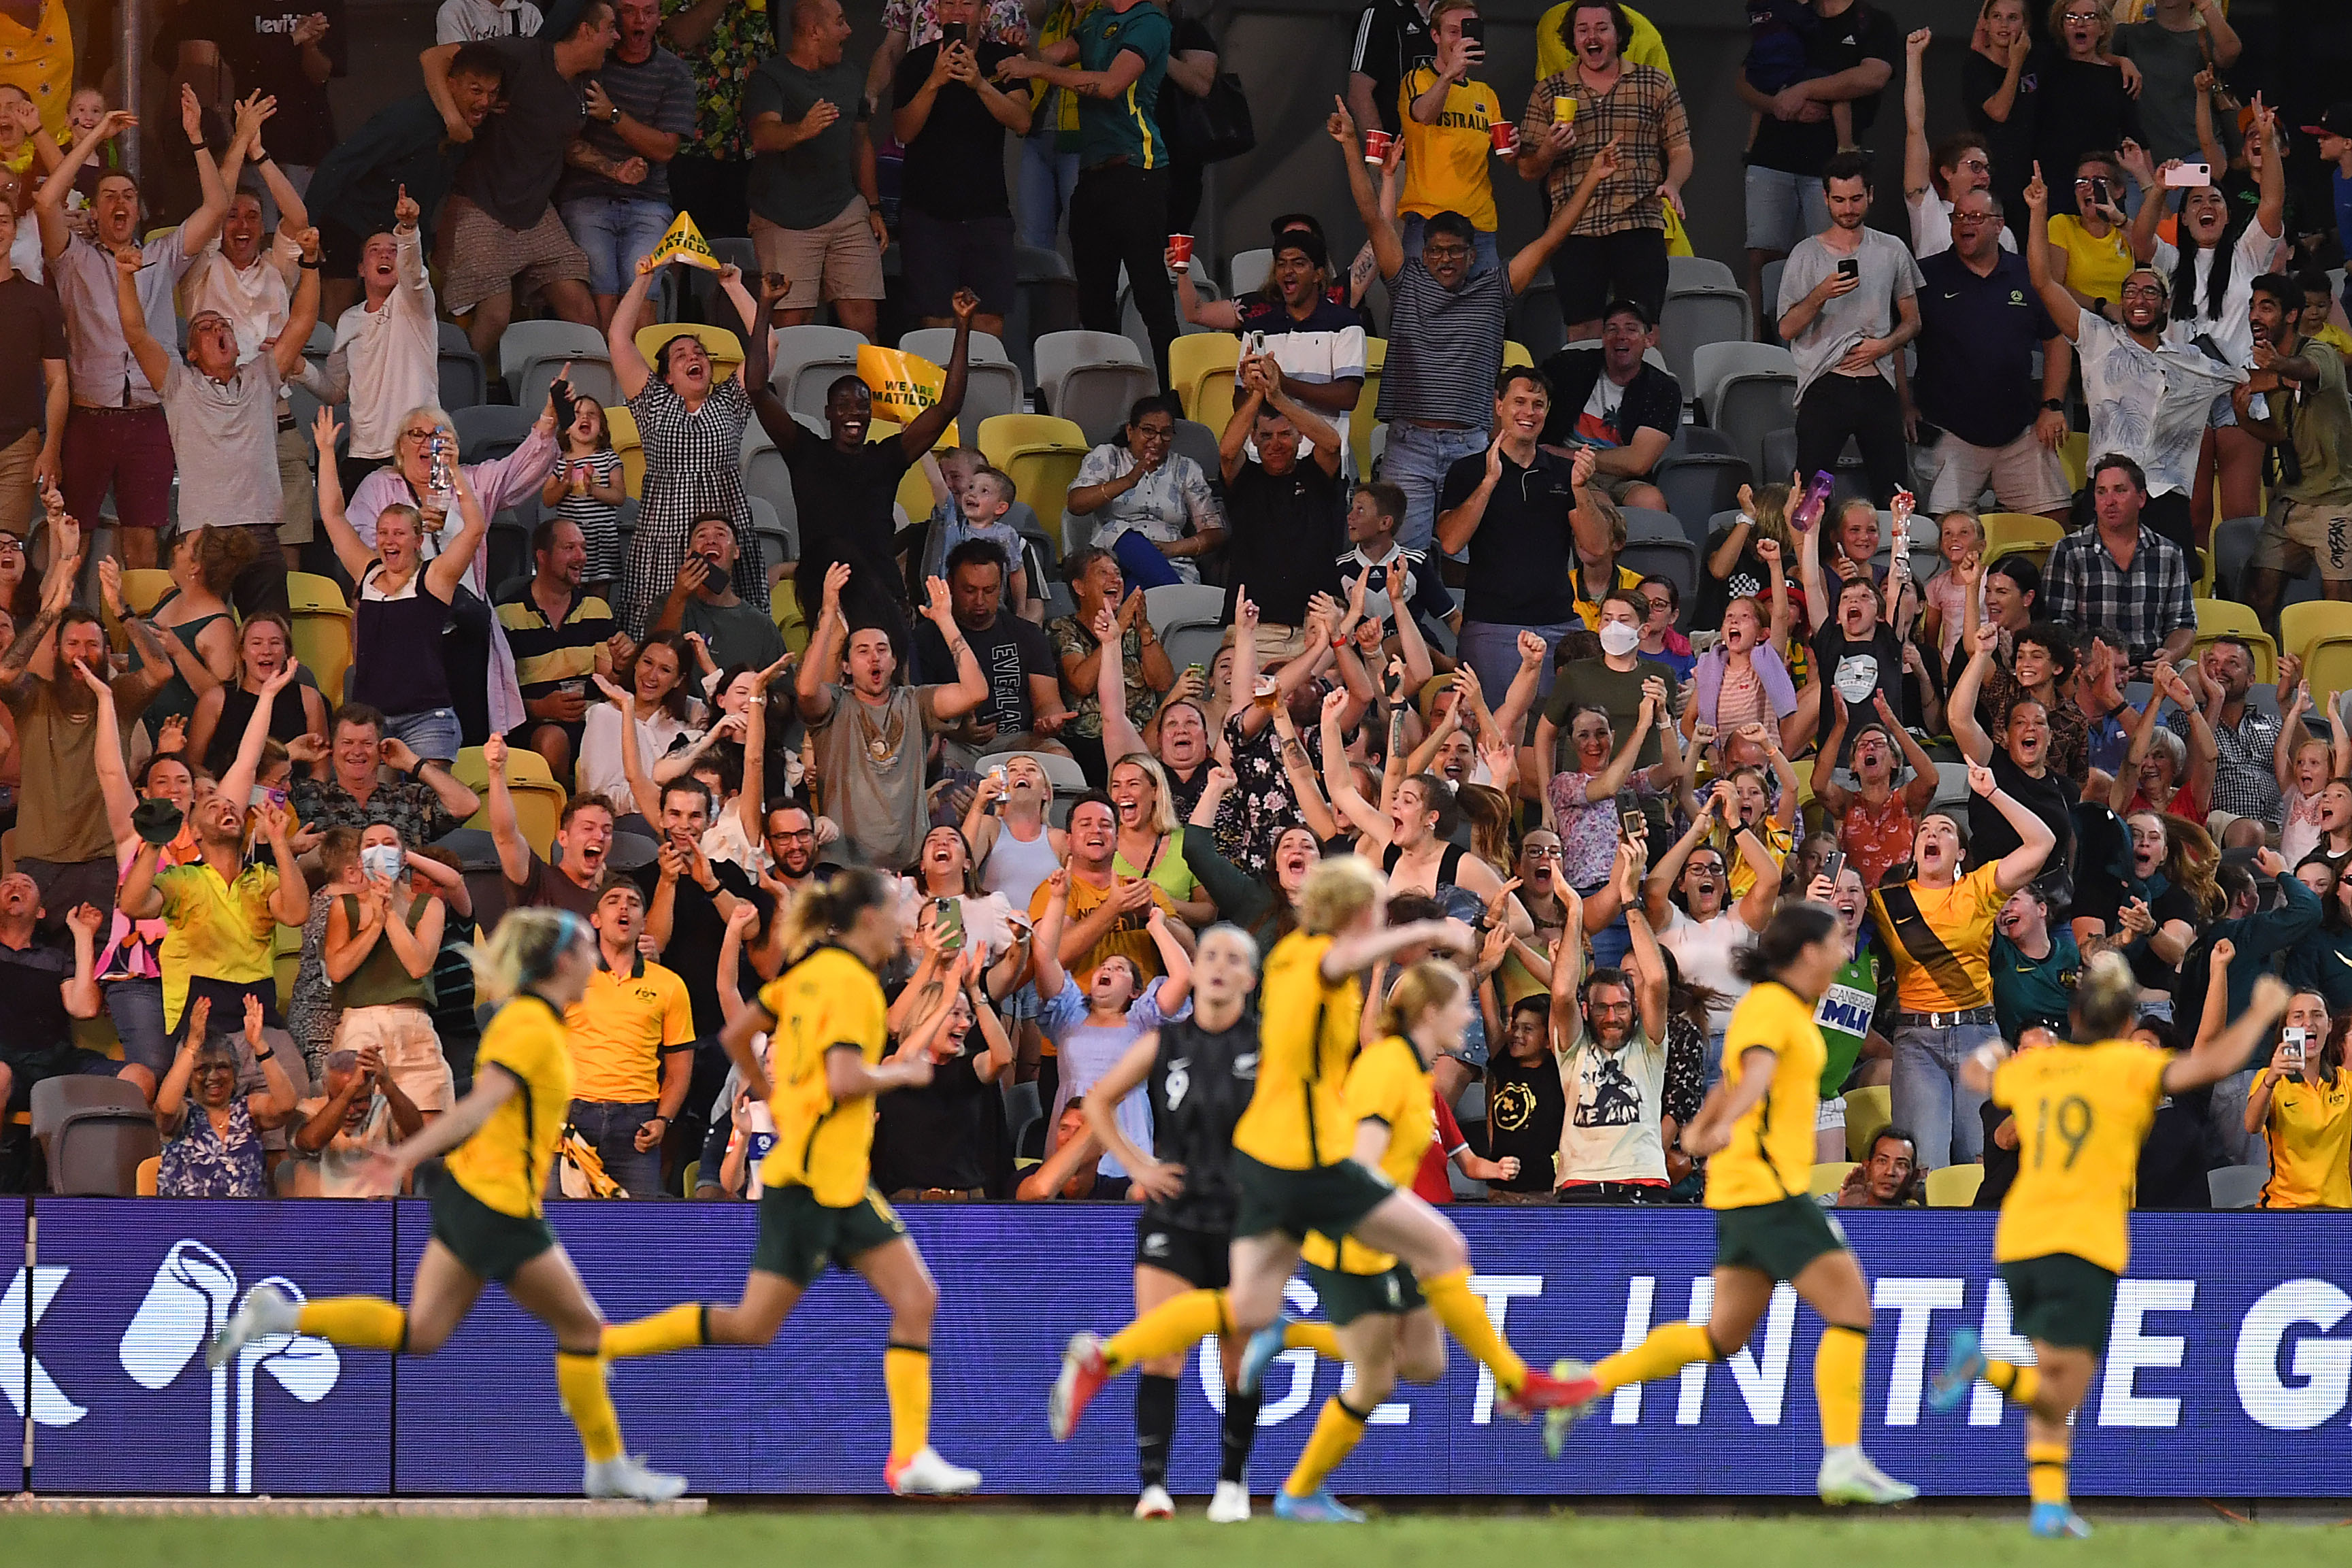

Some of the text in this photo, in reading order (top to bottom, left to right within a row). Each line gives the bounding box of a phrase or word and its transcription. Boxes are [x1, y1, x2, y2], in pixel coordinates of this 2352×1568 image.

[1433, 111, 1491, 134] USTRALIA
[884, 380, 934, 397] WE ARE
[1820, 999, 1872, 1034] MILK
[1165, 1069, 1190, 1112] 9
[2035, 1094, 2092, 1171] 19
